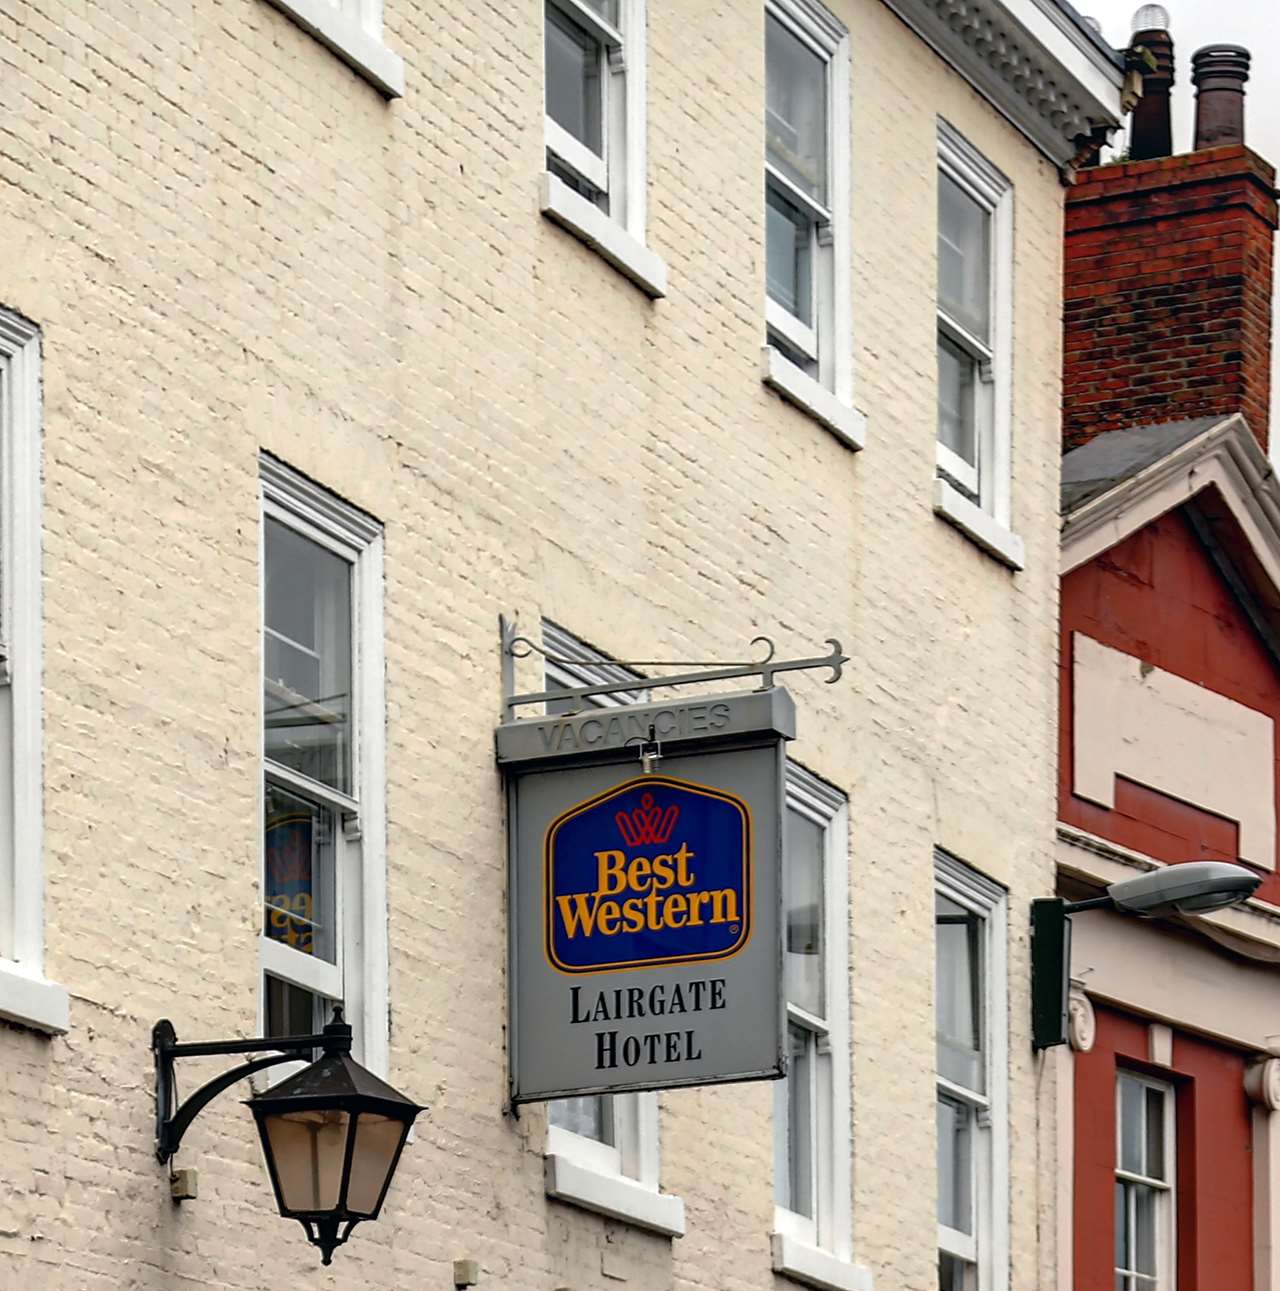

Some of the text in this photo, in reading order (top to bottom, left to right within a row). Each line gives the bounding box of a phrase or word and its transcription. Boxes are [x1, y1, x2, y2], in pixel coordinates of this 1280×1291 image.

[537, 703, 731, 751] VACANCIES
[593, 842, 695, 896] Best
[555, 883, 740, 939] Western
[570, 978, 726, 1024] LAIRGATE
[595, 1030, 702, 1069] HOTEL
